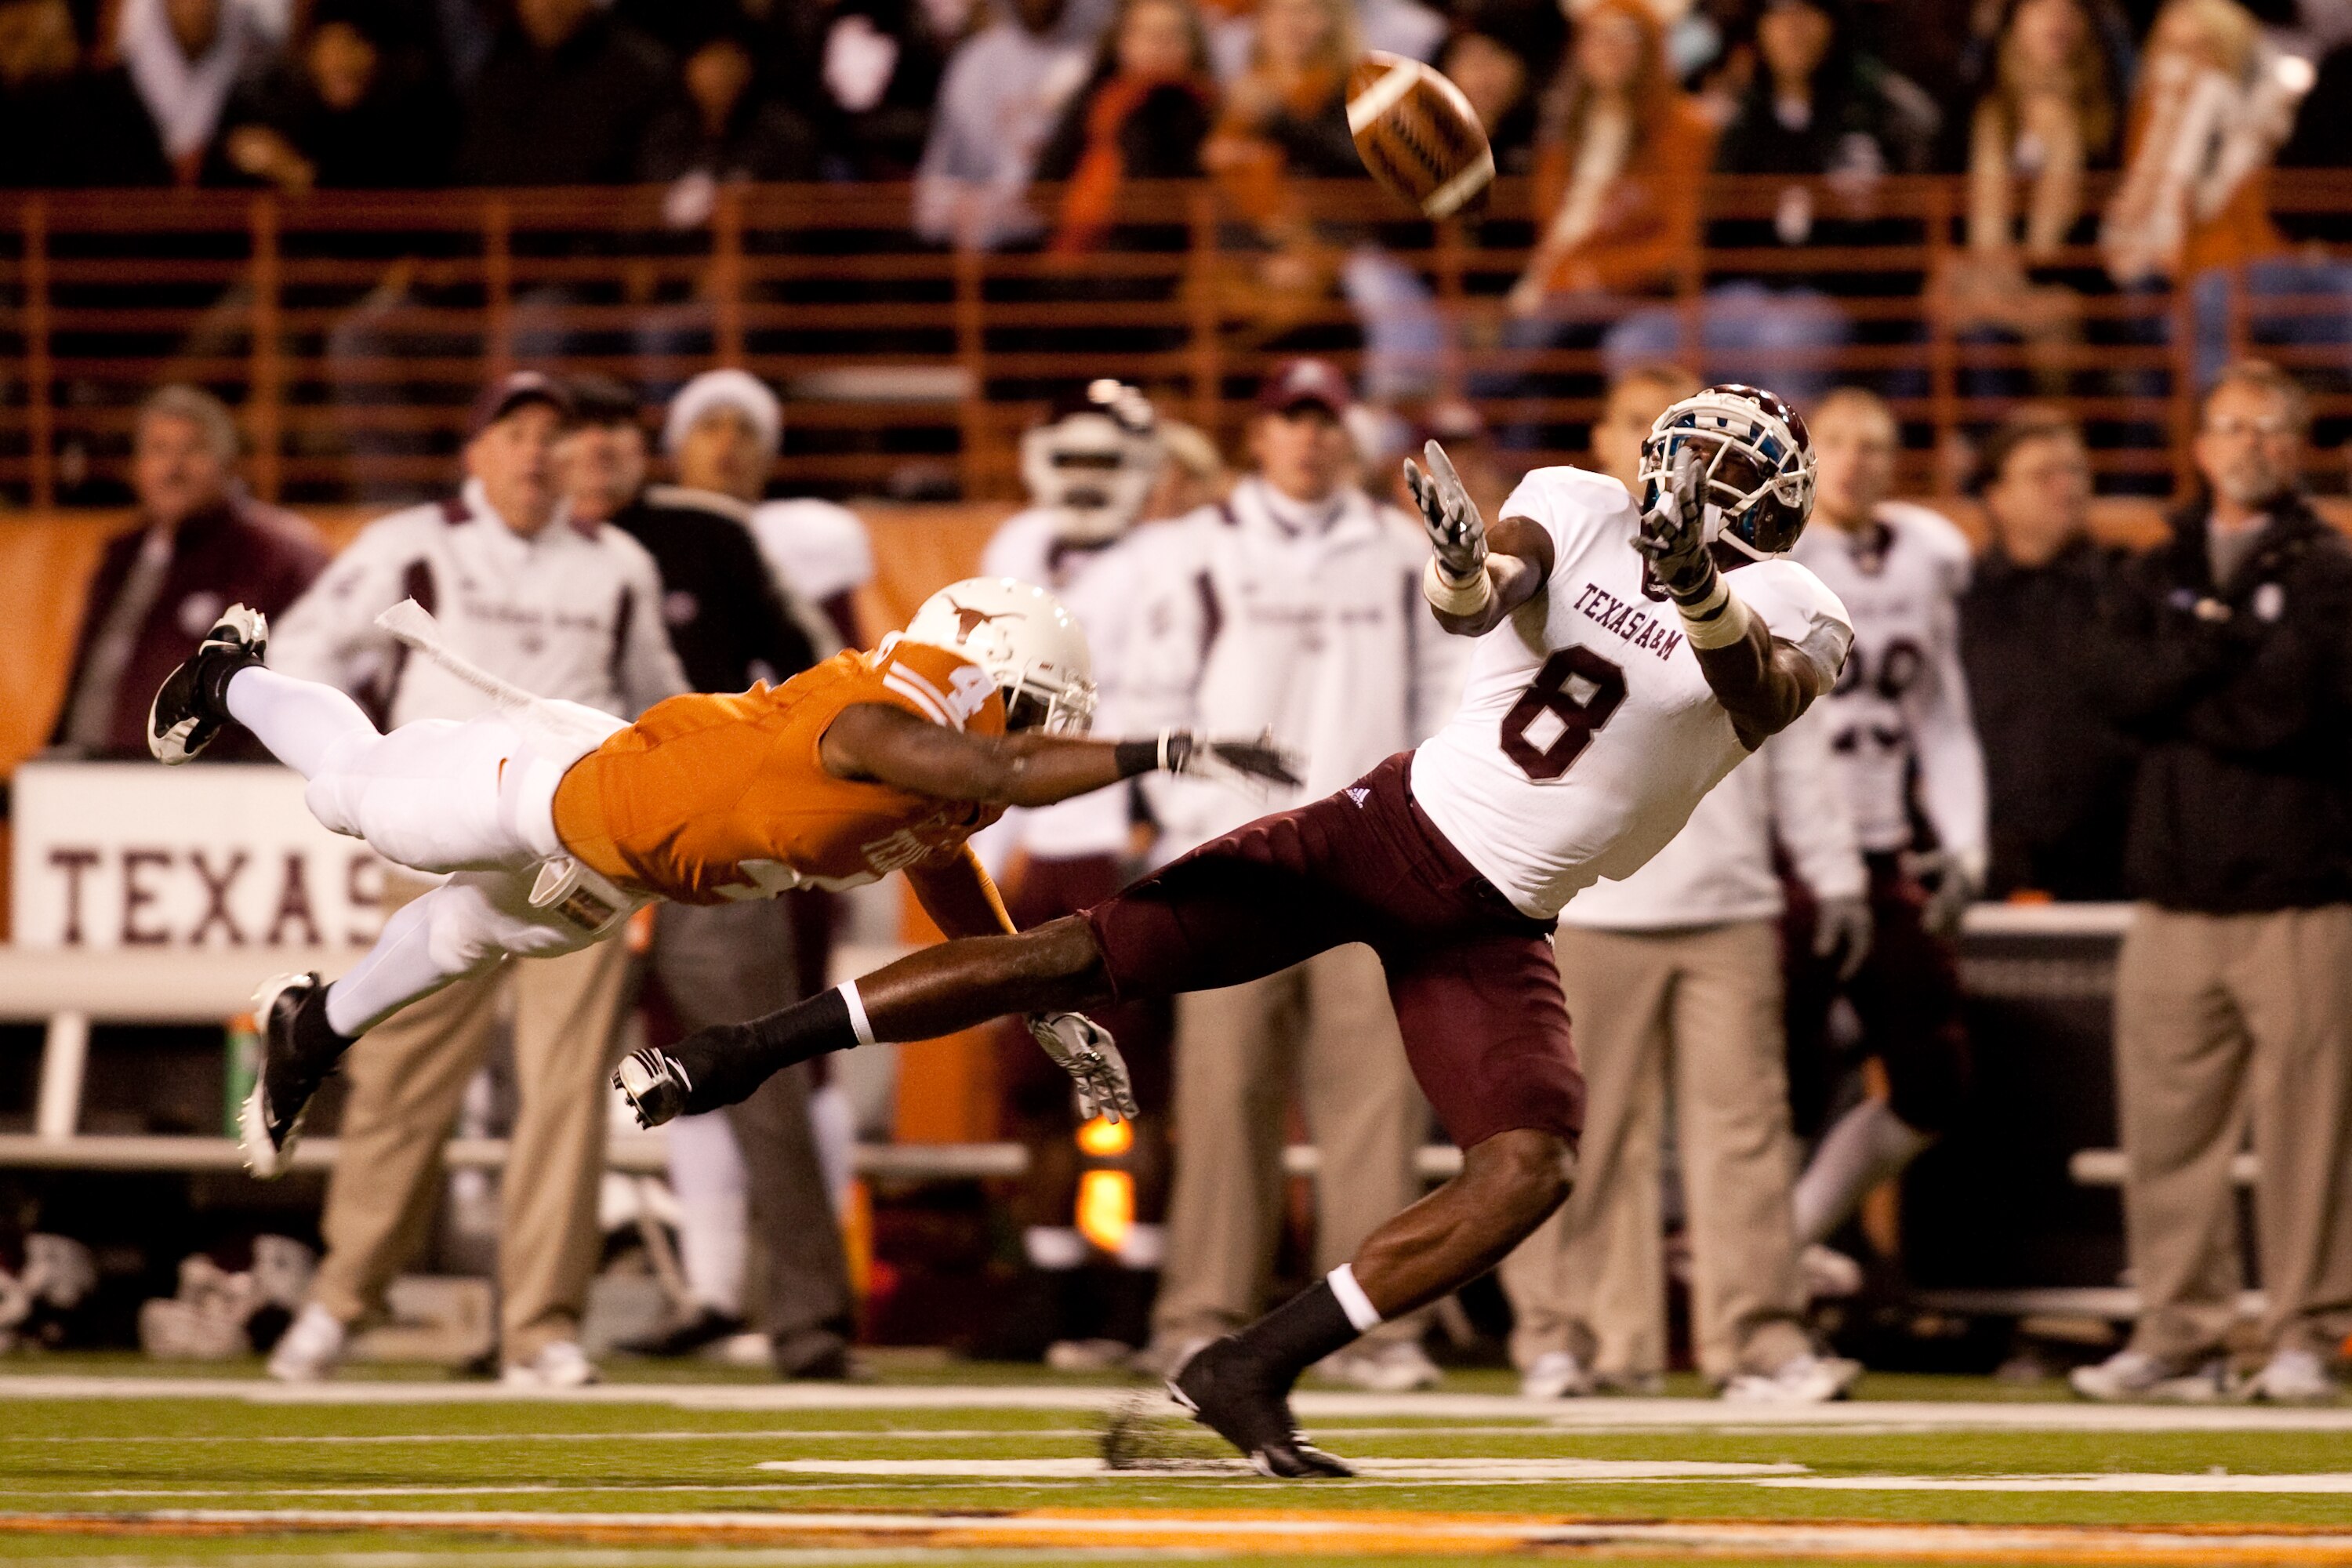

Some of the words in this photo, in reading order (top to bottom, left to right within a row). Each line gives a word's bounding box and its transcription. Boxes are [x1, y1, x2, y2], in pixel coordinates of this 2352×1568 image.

[1573, 582, 1646, 641] TEXAS
[1634, 619, 1684, 662] A&M
[946, 664, 1000, 722] 4
[1498, 642, 1630, 784] 8
[47, 849, 389, 946] TEXAS
